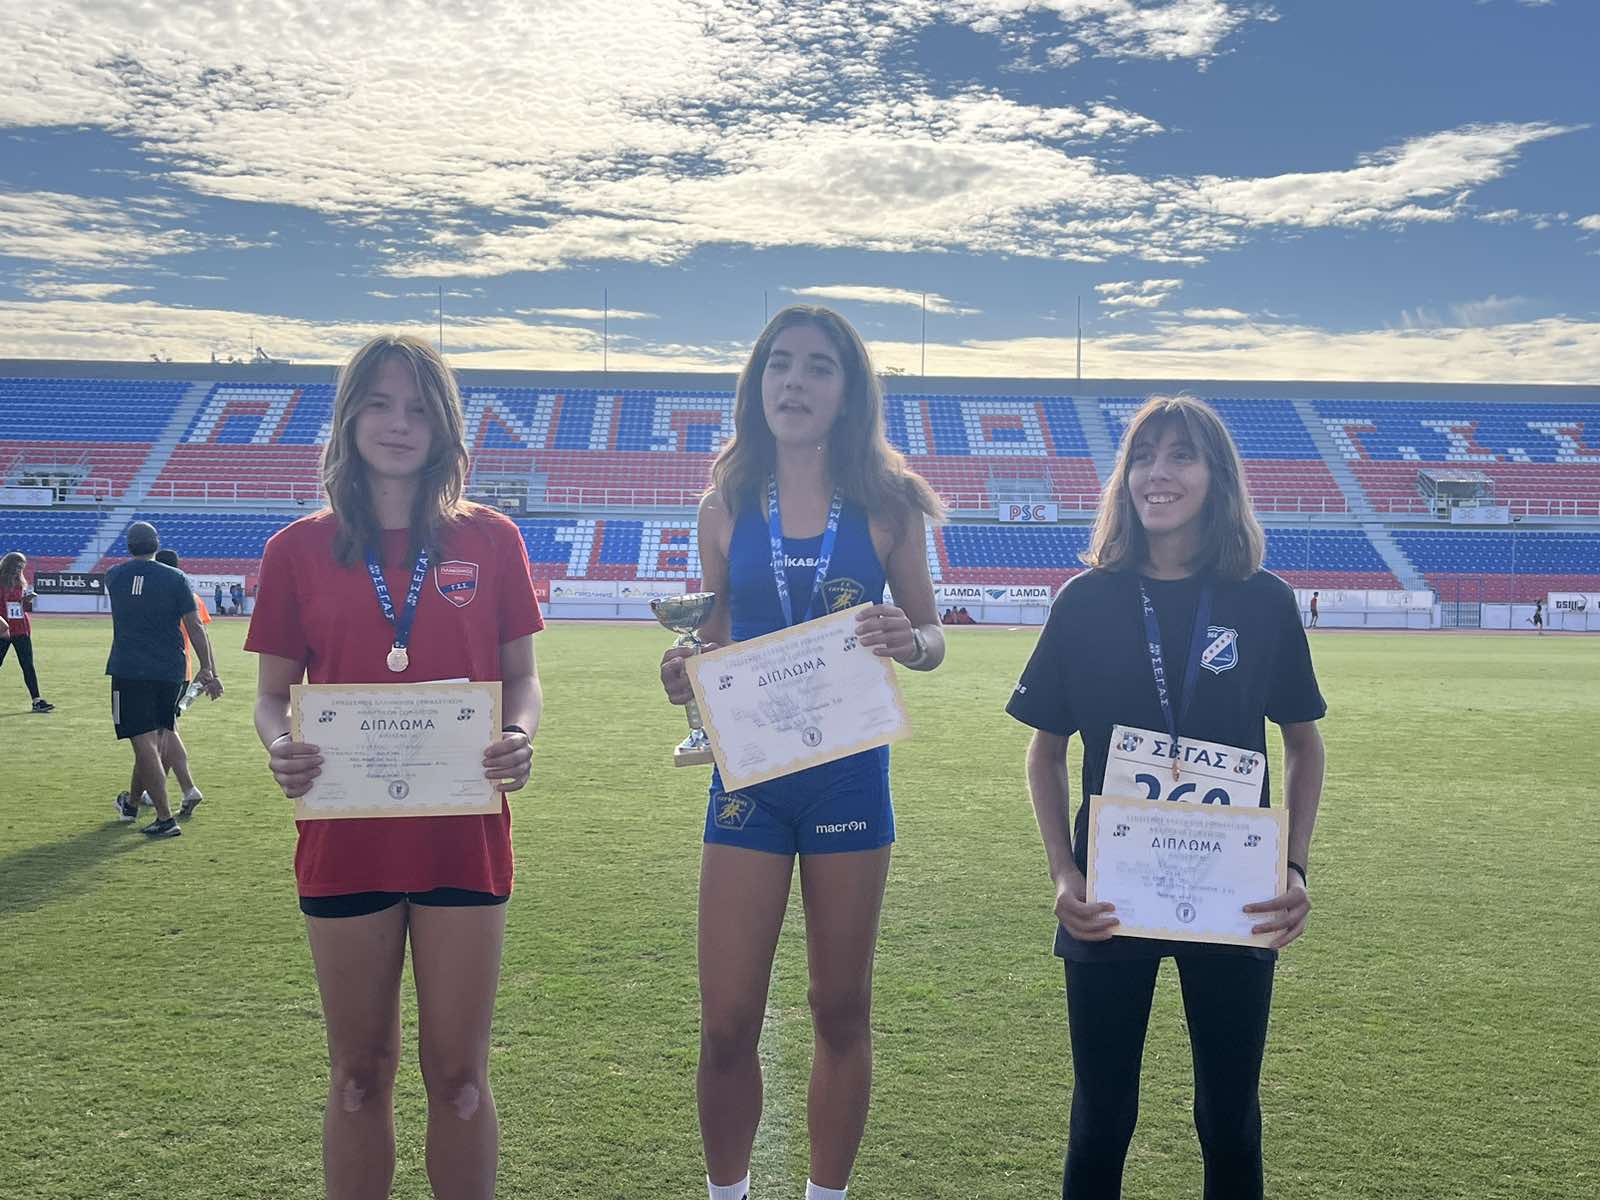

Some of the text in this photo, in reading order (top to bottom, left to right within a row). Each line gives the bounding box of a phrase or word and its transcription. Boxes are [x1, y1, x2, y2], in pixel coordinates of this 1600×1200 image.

[1009, 504, 1047, 521] PSC
[59, 575, 86, 587] habits
[944, 588, 982, 597] LAMDA
[1010, 588, 1048, 598] LAMDA
[757, 657, 827, 688] ΔΙΠΛΩΜΑ
[360, 719, 436, 732] ΔΙΠΛΩΜΑ
[815, 820, 868, 835] macron
[1151, 837, 1223, 853] ΔΙΠΛΩΜΑ
